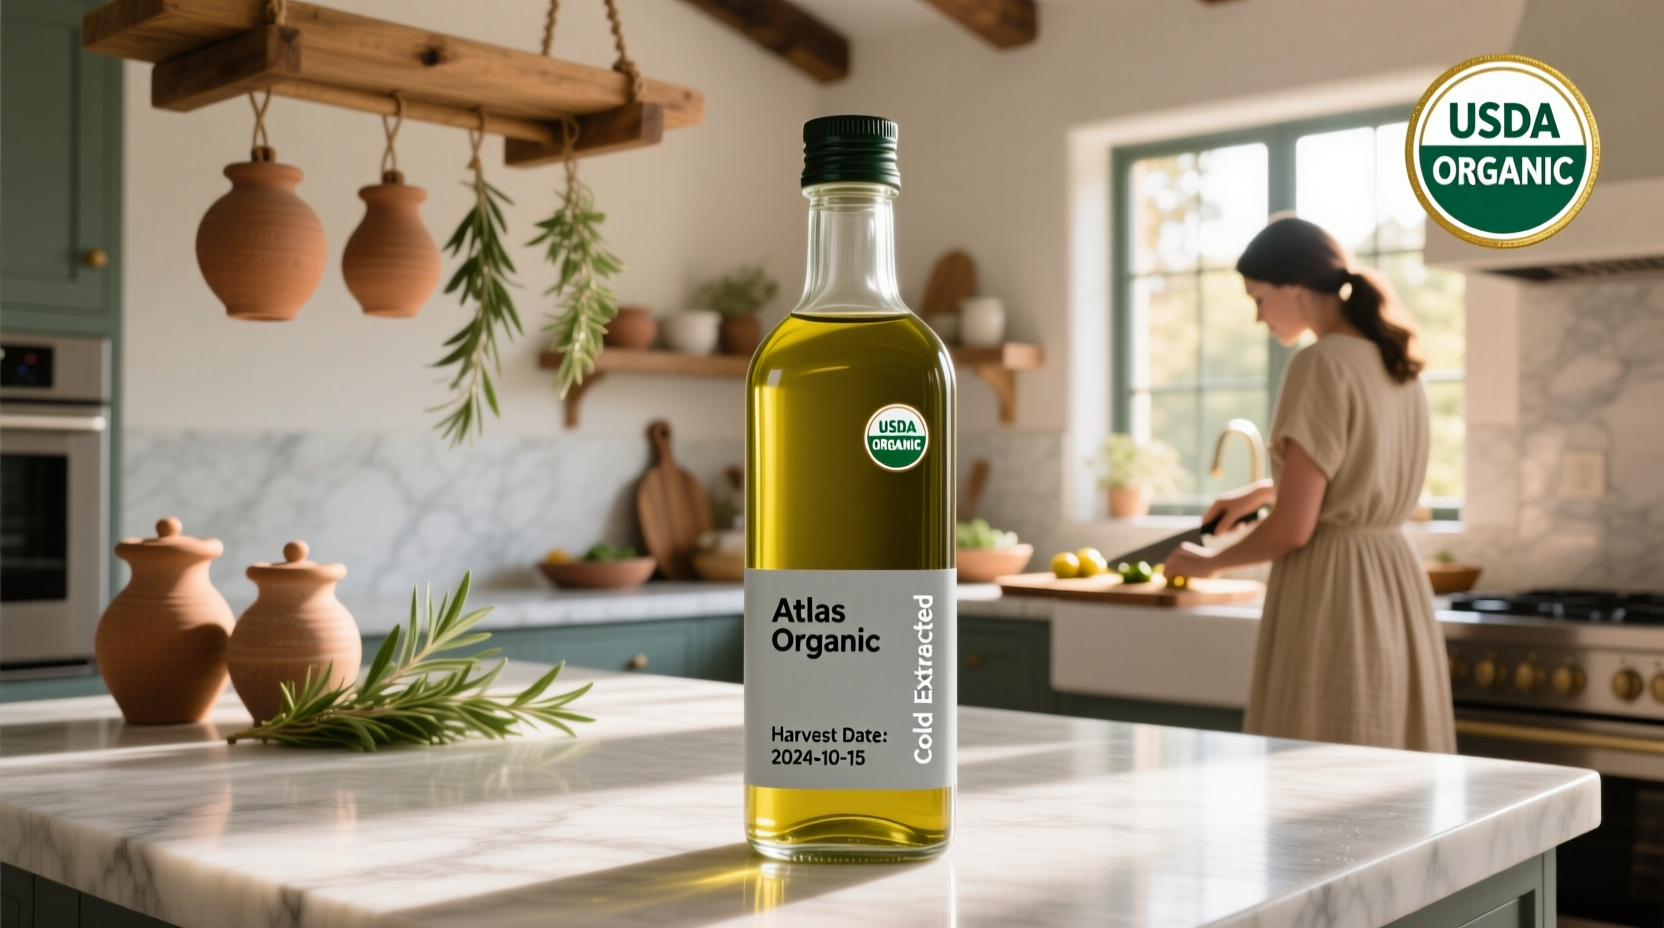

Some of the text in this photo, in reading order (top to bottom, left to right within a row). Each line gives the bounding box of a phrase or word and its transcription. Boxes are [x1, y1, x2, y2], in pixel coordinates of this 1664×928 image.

[879, 419, 917, 434] USDA
[872, 438, 921, 451] ORGANIC
[772, 597, 846, 624] Atlas
[771, 627, 881, 660] Organic
[912, 594, 934, 765] Cold Extracted
[771, 726, 888, 744] Harvest Date:
[771, 749, 866, 766] 2024-10-15
